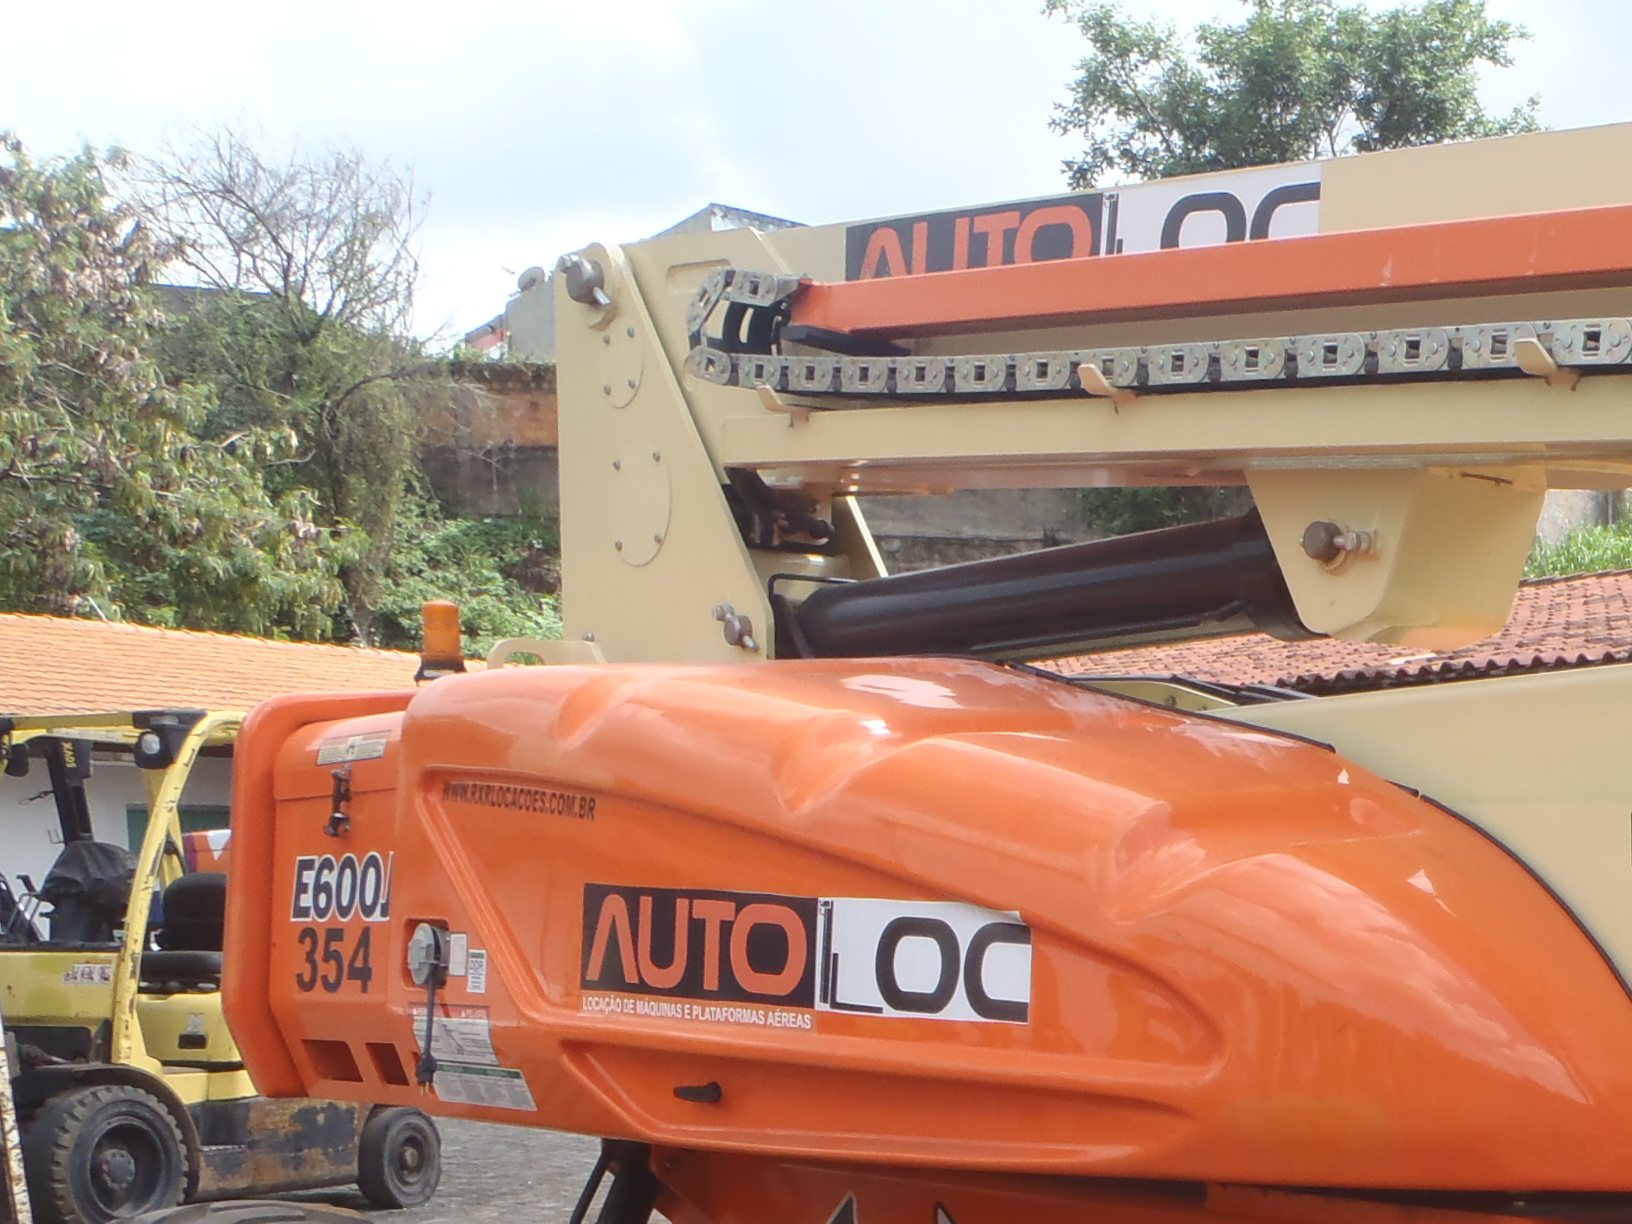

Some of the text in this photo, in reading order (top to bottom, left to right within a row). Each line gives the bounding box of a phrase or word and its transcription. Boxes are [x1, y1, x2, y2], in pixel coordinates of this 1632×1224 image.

[295, 925, 373, 994] 354
[582, 995, 812, 1029] LOCAÇÃO DE MÁQUINAS E PLATAFORMAS AÉREAS
